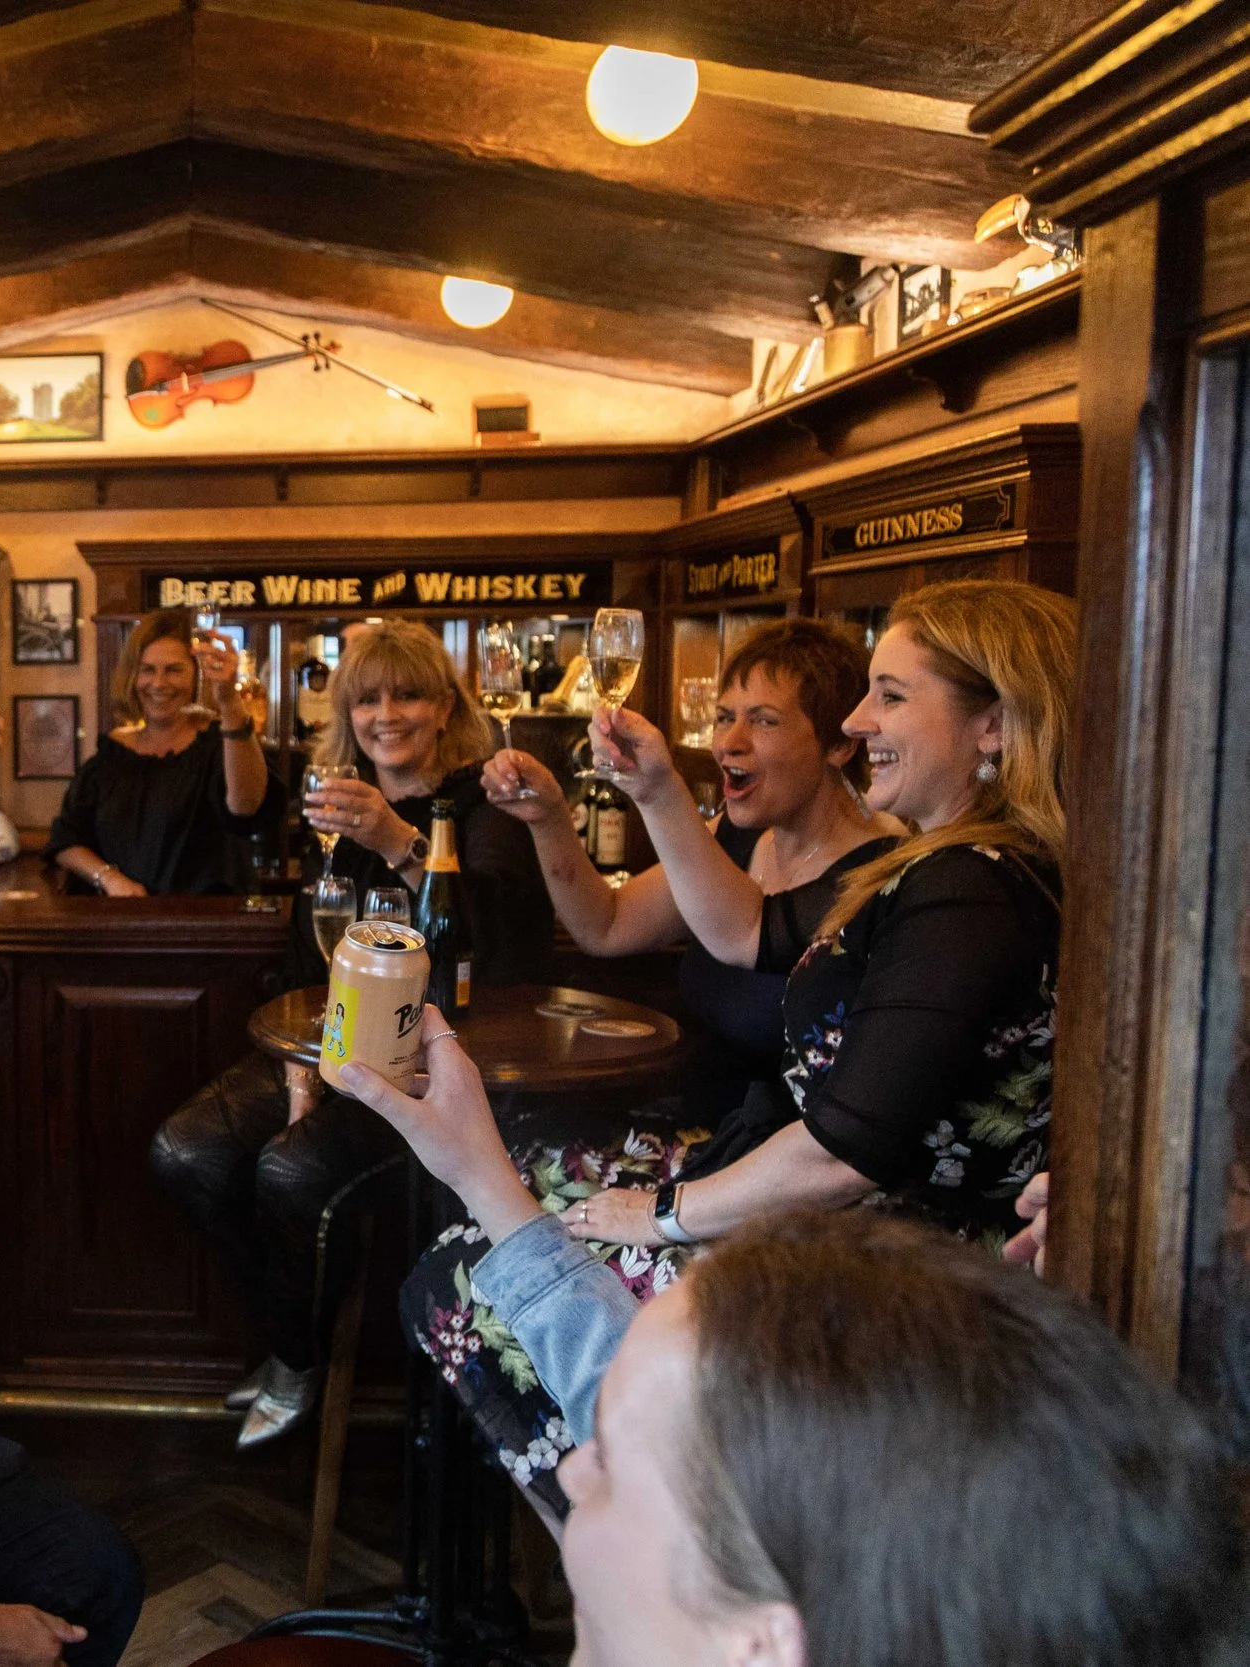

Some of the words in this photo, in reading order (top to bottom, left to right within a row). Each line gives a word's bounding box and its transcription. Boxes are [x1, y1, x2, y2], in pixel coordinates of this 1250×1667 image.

[855, 503, 963, 547] GUINNESS
[160, 577, 256, 607] BEER
[261, 575, 362, 605] WINE
[373, 571, 406, 602] AND
[414, 572, 587, 602] WHISKEY
[689, 563, 718, 594] STOUT
[732, 552, 776, 591] PORTER
